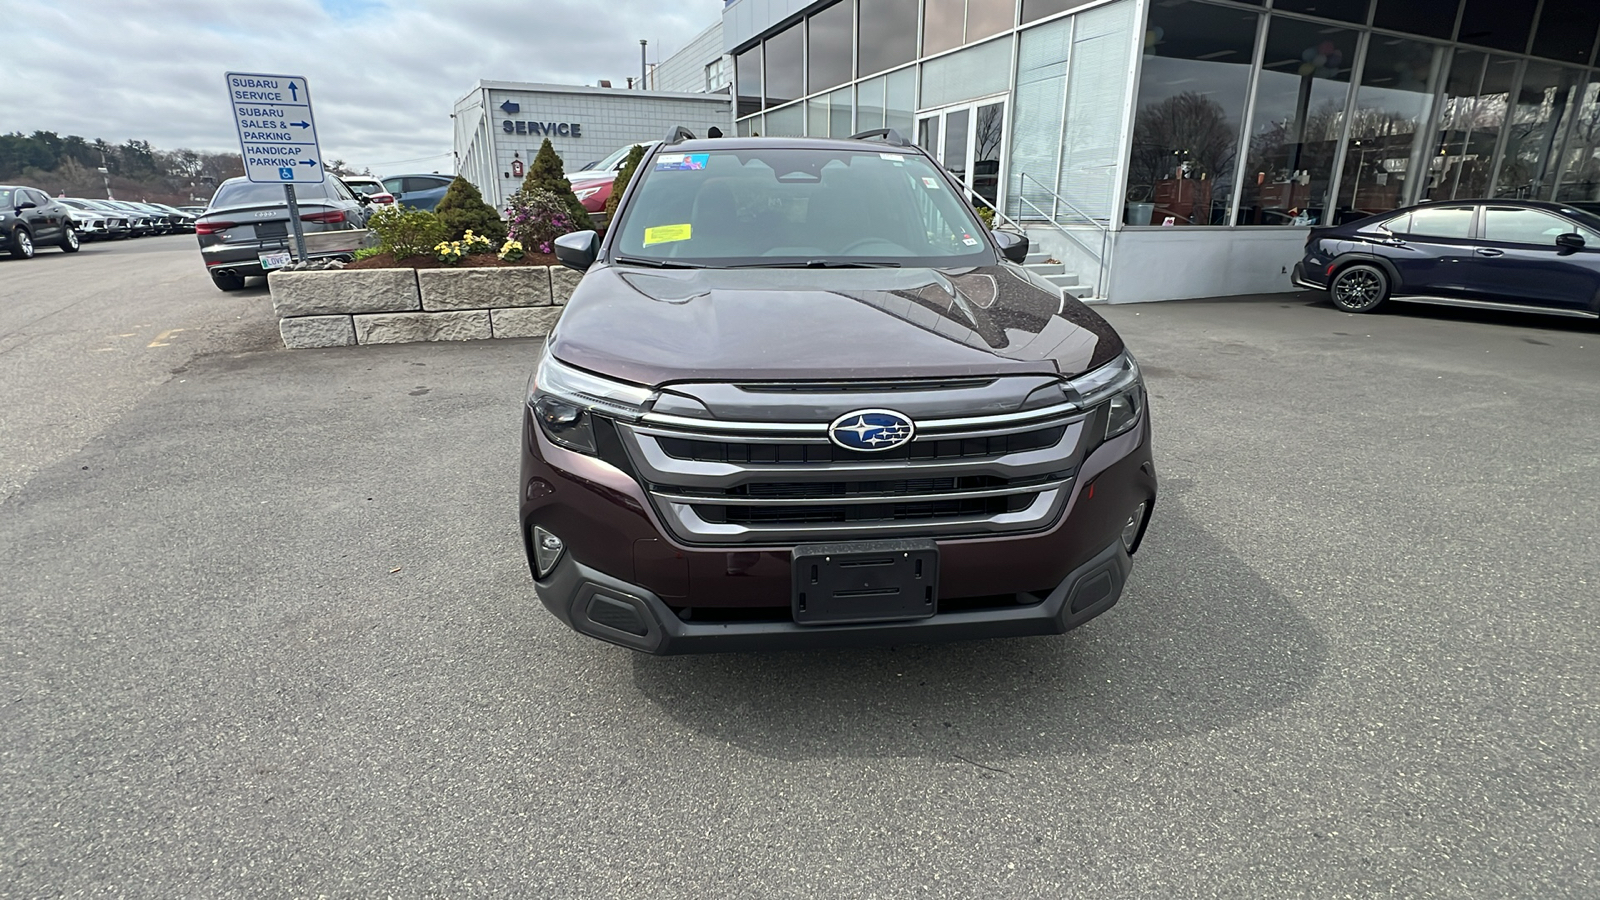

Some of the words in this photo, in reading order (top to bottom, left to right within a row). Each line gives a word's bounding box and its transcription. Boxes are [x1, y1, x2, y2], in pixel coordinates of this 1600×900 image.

[232, 78, 278, 89] SUBARU
[235, 90, 282, 101] SERVICE
[238, 107, 284, 117] SUBARU
[241, 119, 277, 128] SALES
[279, 121, 287, 129] &
[503, 120, 581, 137] SERVICE
[243, 131, 291, 140] PARKING
[247, 146, 301, 155] HANDICAP
[249, 157, 297, 167] PARKING
